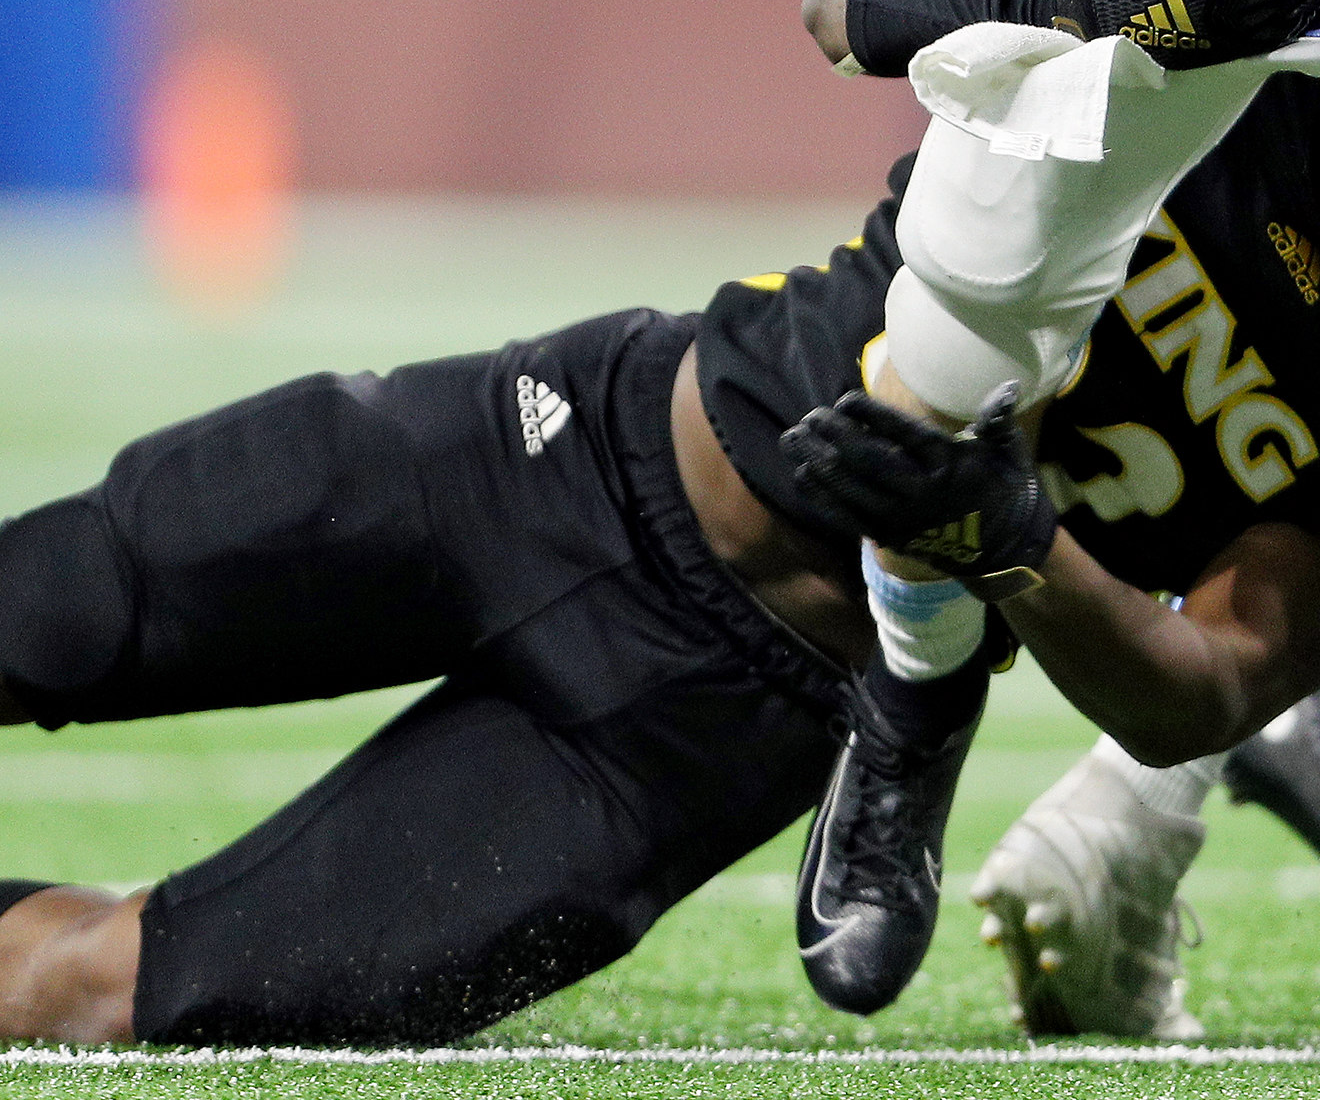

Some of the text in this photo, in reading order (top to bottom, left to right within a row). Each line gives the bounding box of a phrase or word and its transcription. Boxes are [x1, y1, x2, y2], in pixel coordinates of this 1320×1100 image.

[1119, 25, 1211, 49] adidas
[1267, 221, 1320, 305] adidas
[1114, 207, 1320, 503] ING
[516, 375, 544, 457] adidas
